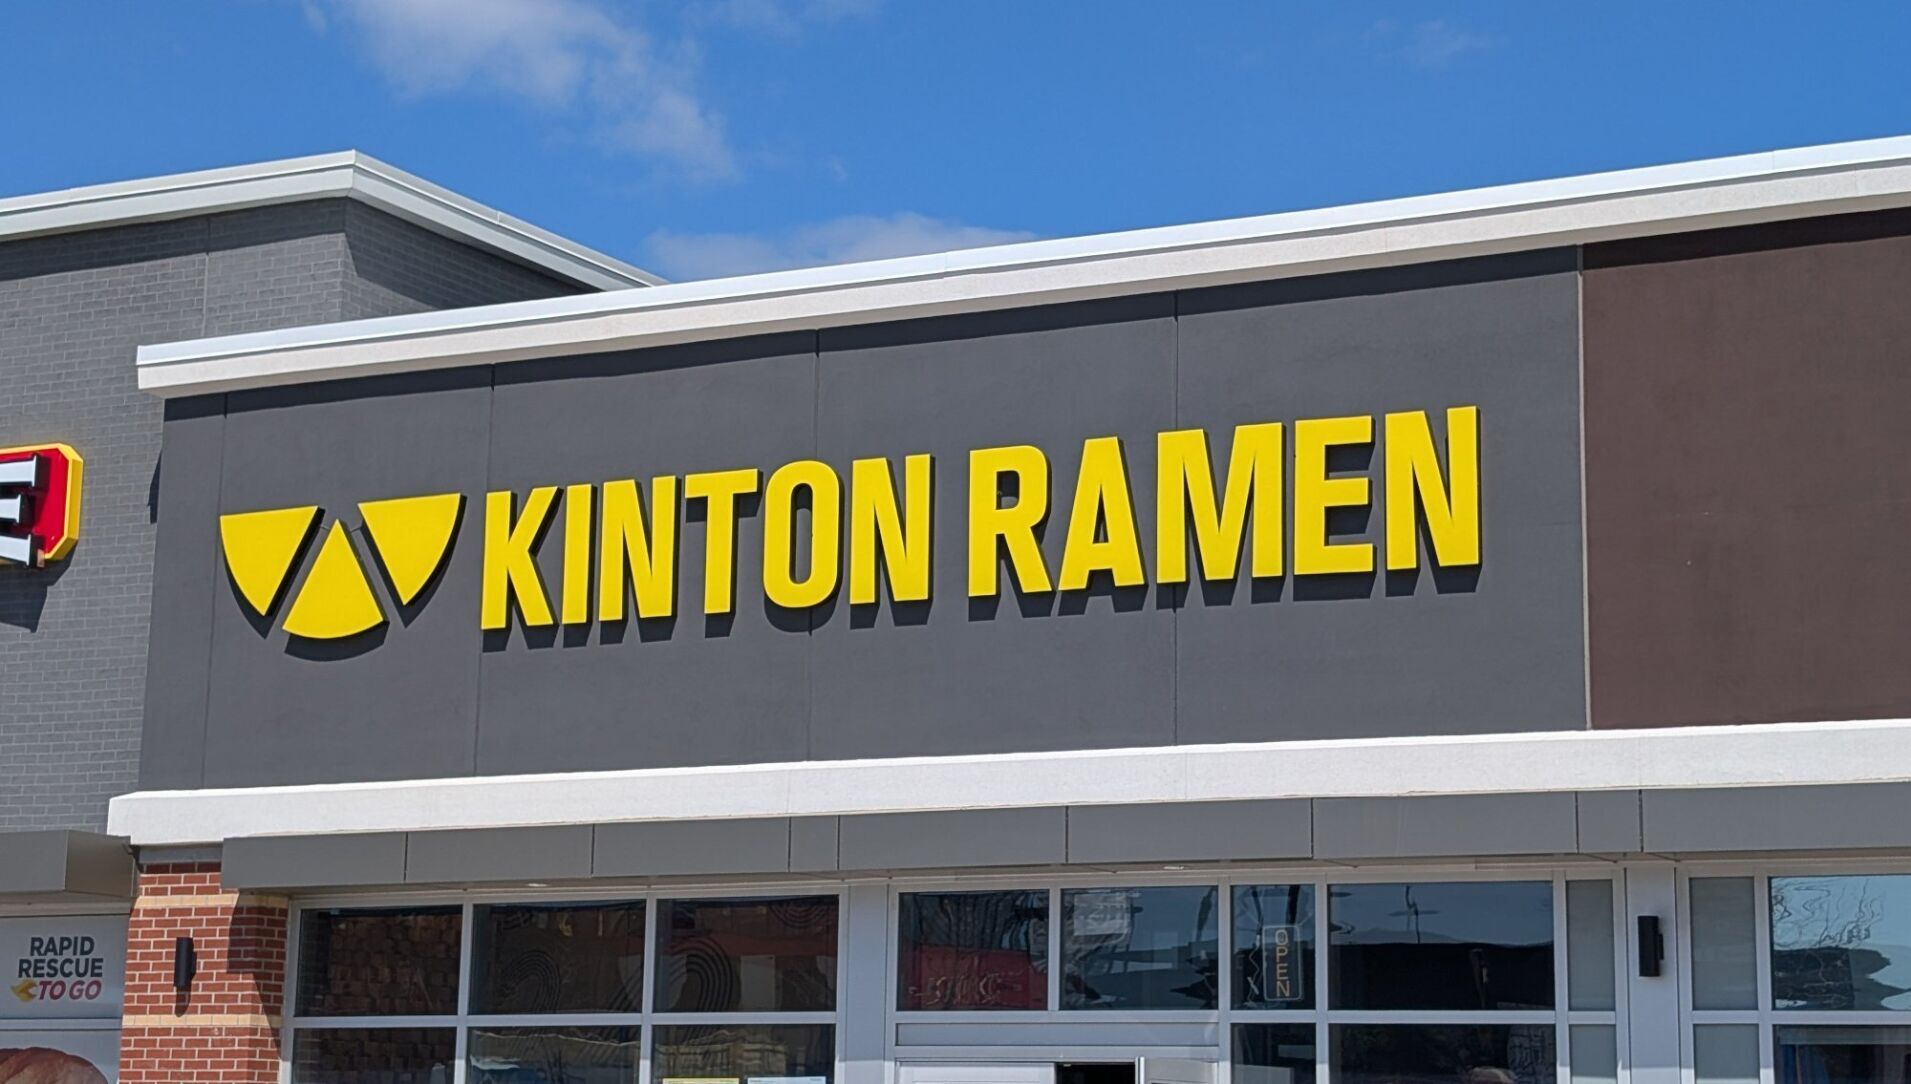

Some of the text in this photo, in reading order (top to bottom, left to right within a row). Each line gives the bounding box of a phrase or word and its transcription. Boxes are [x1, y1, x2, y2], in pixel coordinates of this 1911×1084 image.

[481, 405, 1480, 630] KINTON RAMEN
[30, 936, 95, 956] RAPID
[18, 958, 104, 978] RESCUE
[1275, 929, 1290, 997] OPEN
[39, 980, 102, 1000] TO GO
